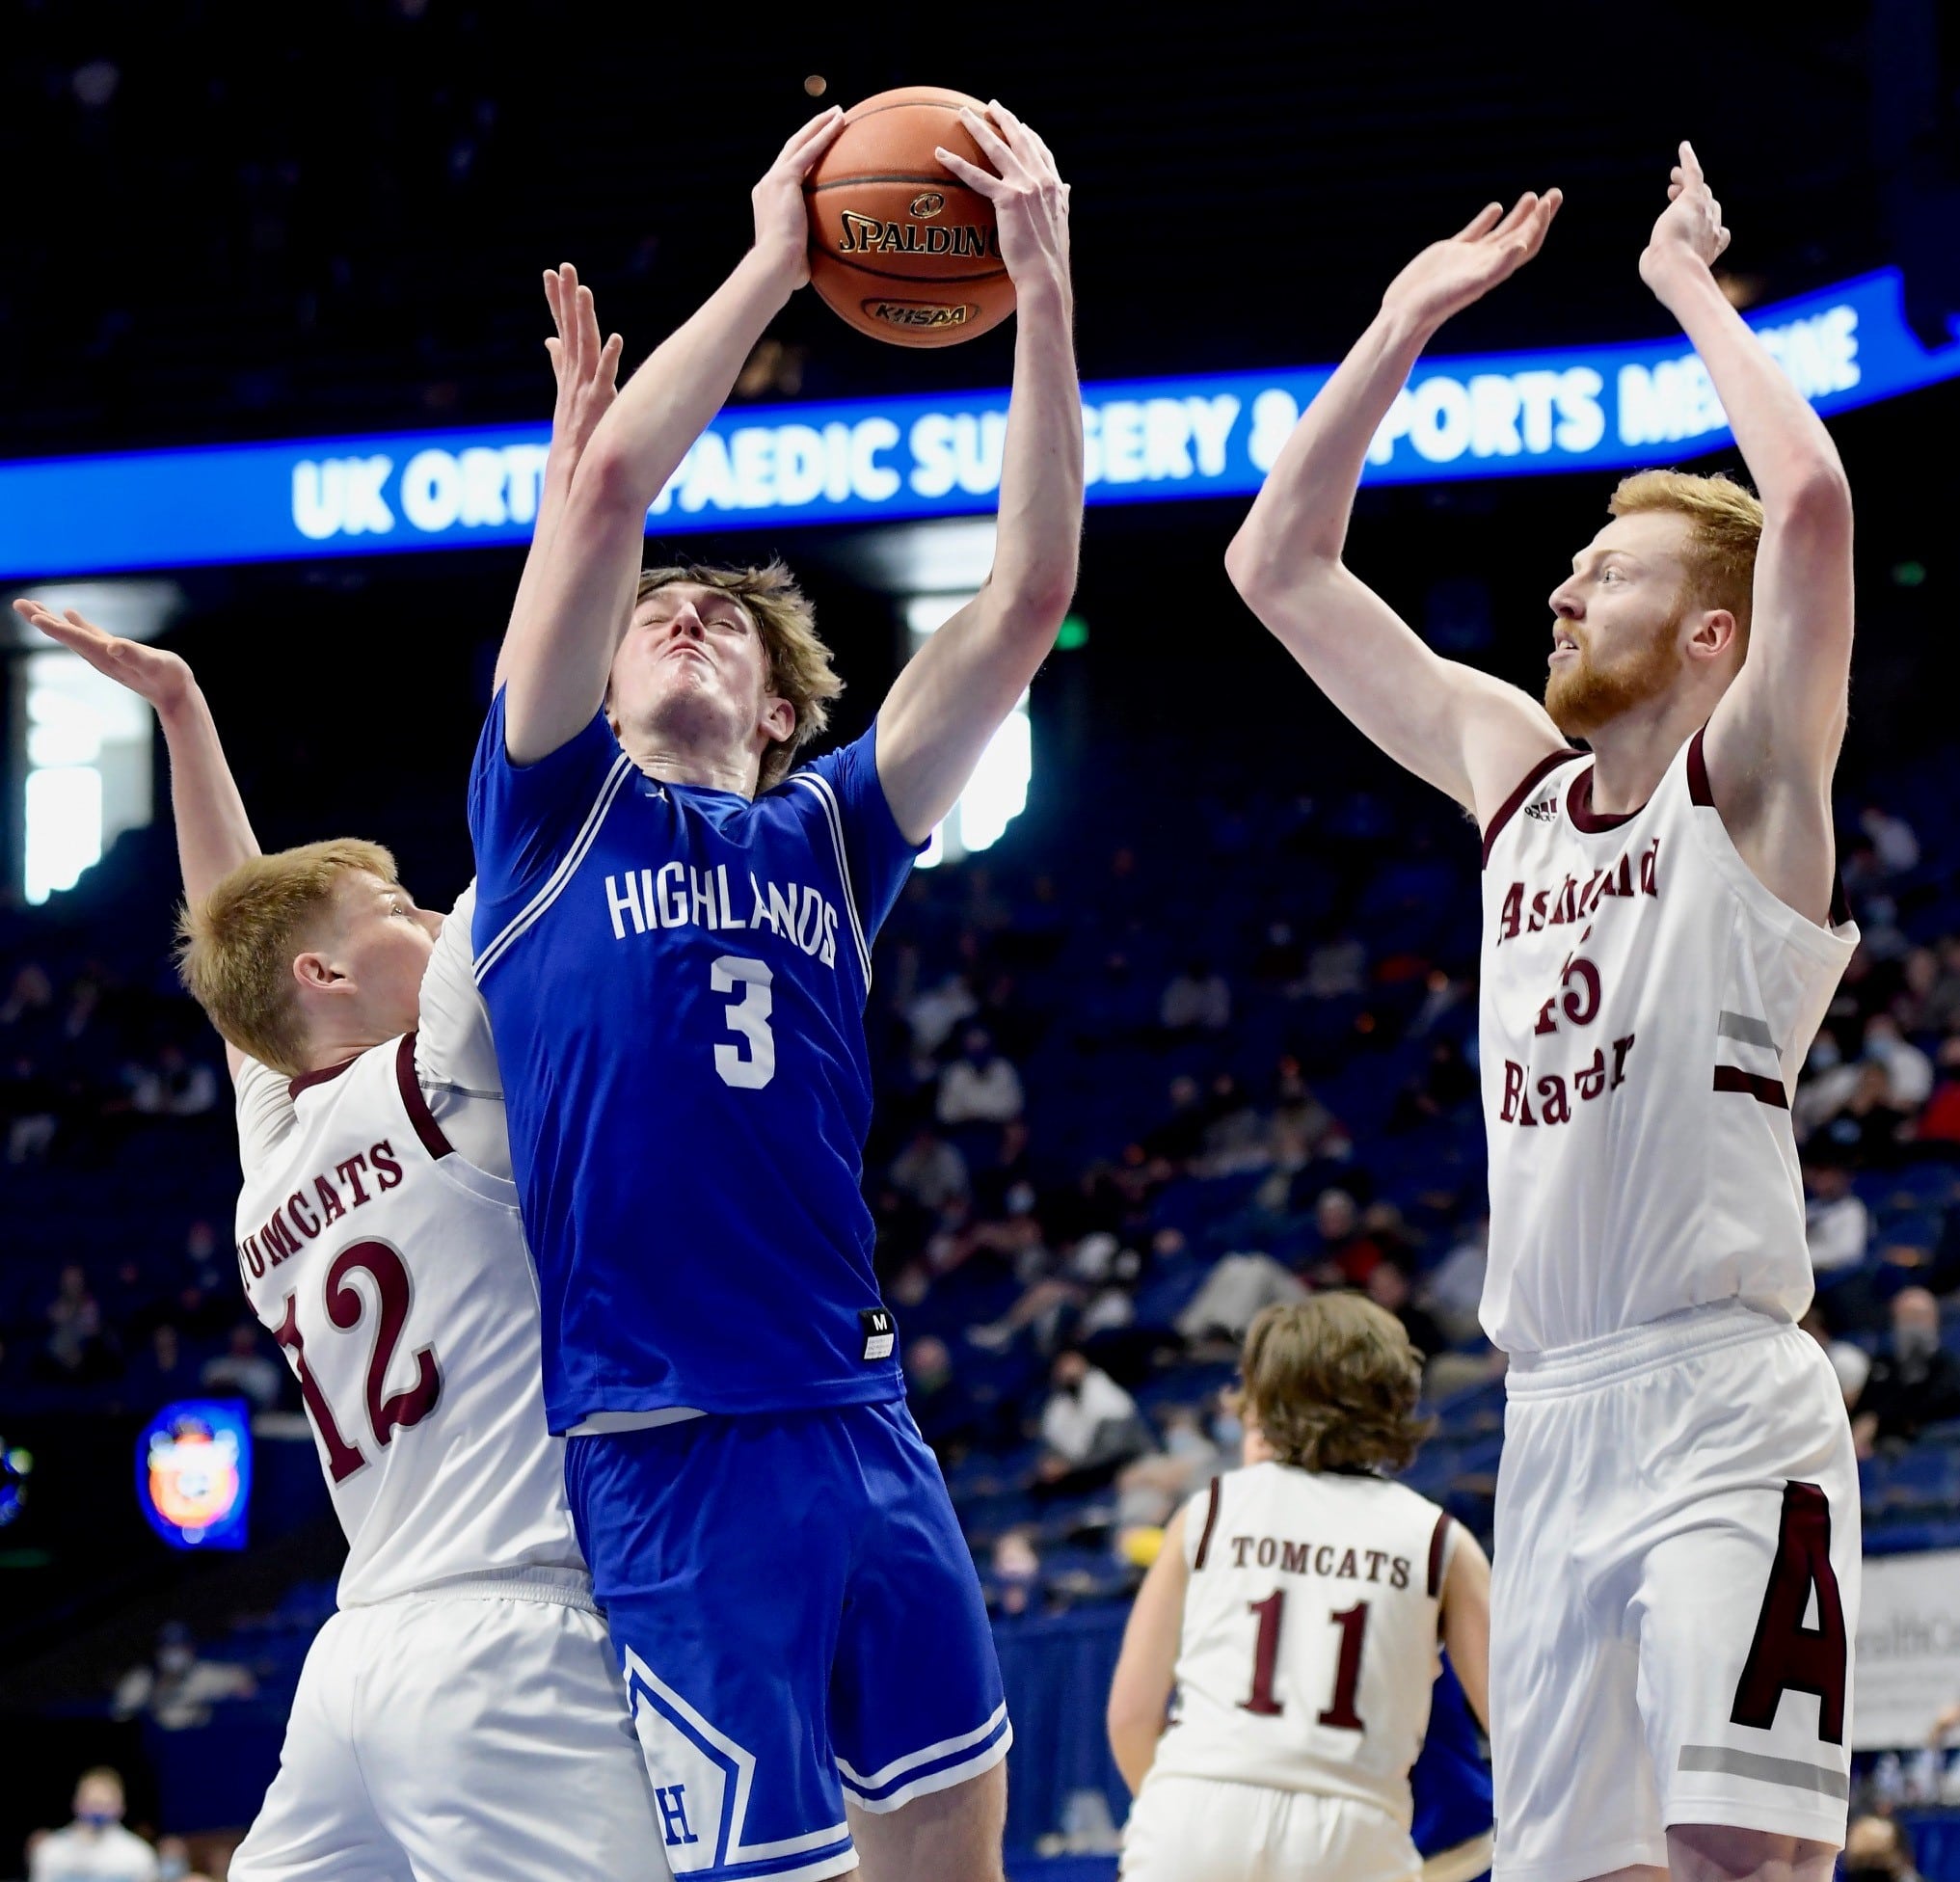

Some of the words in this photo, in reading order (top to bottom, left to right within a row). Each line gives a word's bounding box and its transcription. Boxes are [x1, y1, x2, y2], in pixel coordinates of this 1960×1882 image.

[875, 304, 967, 326] KHSAA
[291, 454, 395, 540] UK
[400, 417, 900, 532] ORTAEDIC
[908, 393, 1242, 487] SUERY
[1367, 366, 1606, 466] PORTS
[604, 861, 839, 970] HIGHLANDS
[711, 955, 774, 1089] 3
[237, 1140, 403, 1292] OMCATS
[272, 1235, 445, 1491] 12
[873, 1314, 888, 1331] M
[1231, 1536, 1412, 1591] TOMCATS
[1730, 1480, 1847, 1746] A
[1235, 1586, 1373, 1734] 11
[655, 1784, 698, 1846] H
